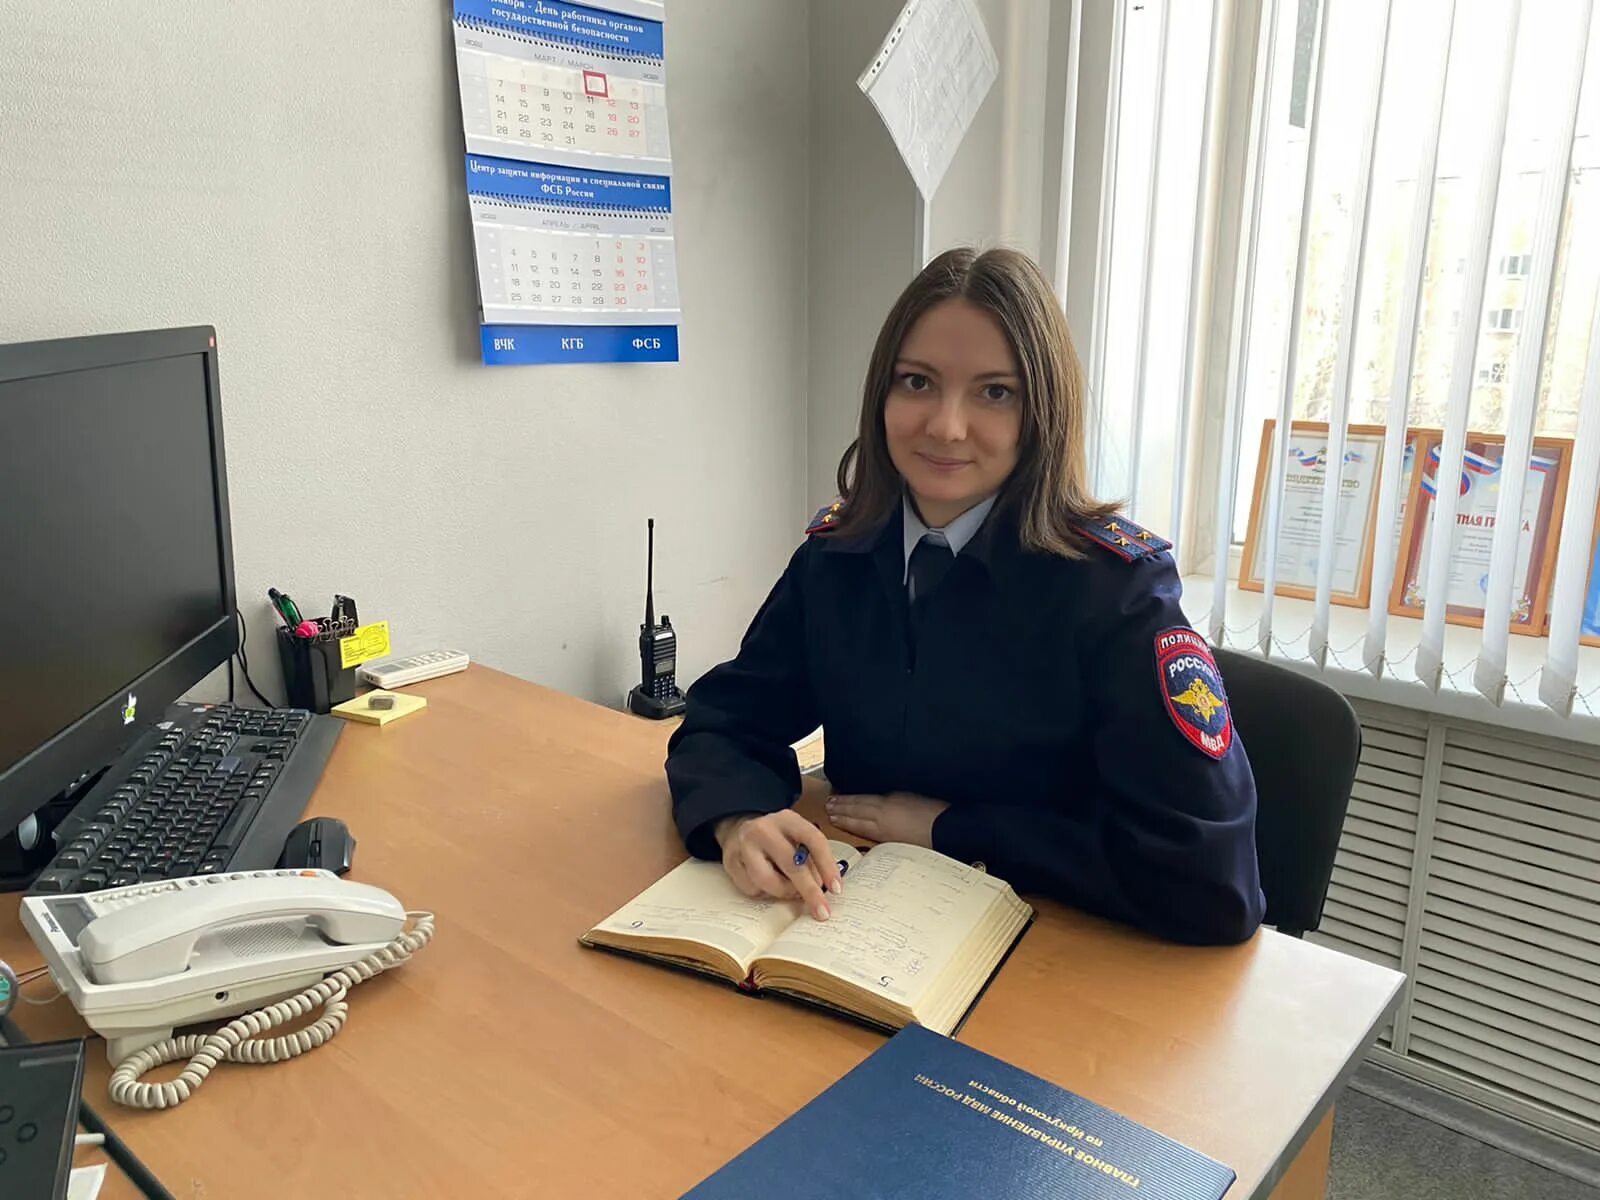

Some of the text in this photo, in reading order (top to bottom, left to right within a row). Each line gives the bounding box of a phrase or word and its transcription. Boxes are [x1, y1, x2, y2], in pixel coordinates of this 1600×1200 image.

[488, 0, 525, 9] кабря
[535, 1, 559, 16] День
[561, 9, 607, 26] работника
[609, 20, 644, 33] органов
[491, 7, 630, 42] государственной безопасности
[470, 159, 496, 175] Центр
[498, 167, 529, 178] защиты
[530, 171, 581, 185] информации
[590, 178, 641, 188] специальной
[643, 183, 665, 191] связи
[541, 183, 594, 198] ФСБ России
[494, 337, 661, 351] ВЧК КГБ ФСБ
[1169, 656, 1213, 678] РОССИ
[1200, 730, 1225, 752] МВД
[877, 975, 895, 988] 5
[968, 1080, 1104, 1148] по Иркутской области
[913, 1073, 1140, 1187] ГЛАВНОЕ УПРАВЛЕНИЕ МВД РОССИИ
